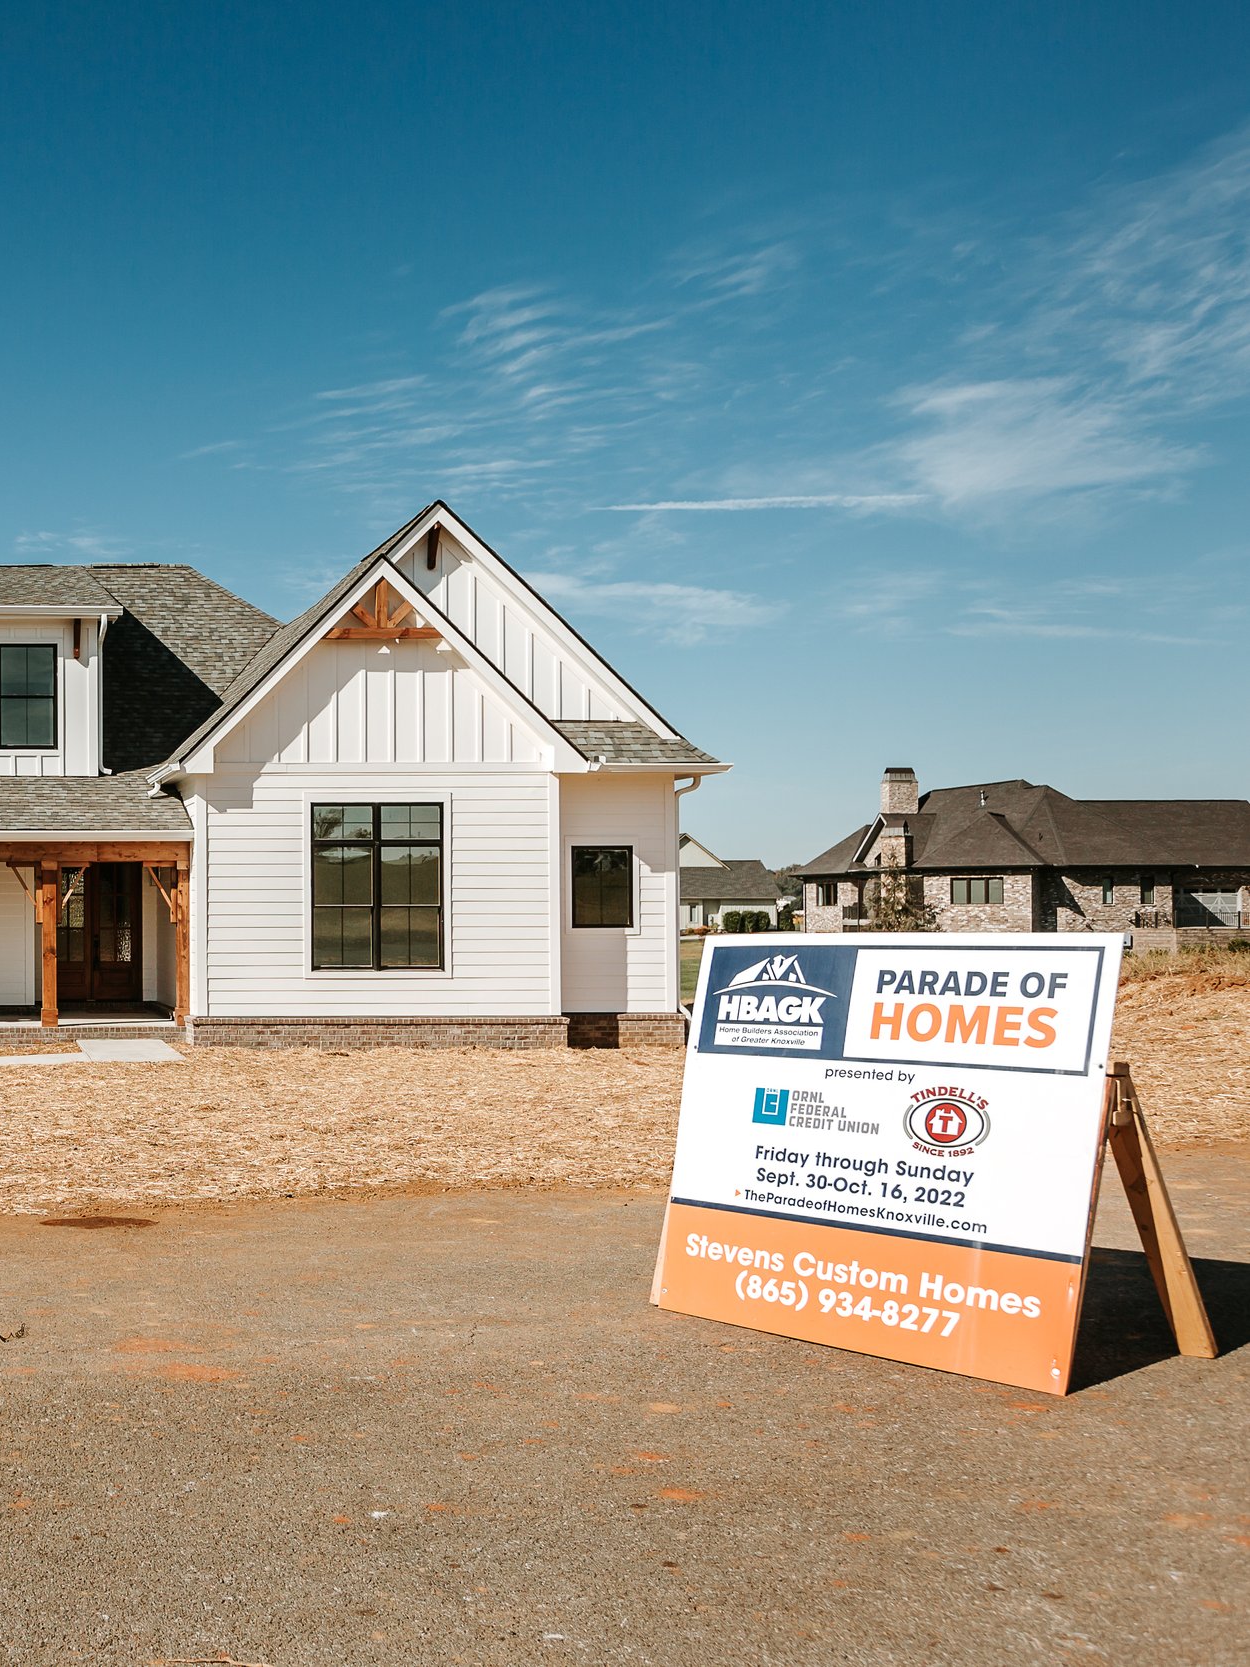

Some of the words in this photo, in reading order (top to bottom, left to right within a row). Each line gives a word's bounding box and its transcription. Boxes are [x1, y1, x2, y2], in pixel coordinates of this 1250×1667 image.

[876, 969, 1010, 997] PARADE
[1019, 971, 1069, 999] OF
[717, 995, 827, 1024] HBAGK
[742, 1027, 772, 1035] Builders
[774, 1029, 819, 1037] Association
[870, 1002, 1058, 1048] HOMES
[770, 1038, 805, 1046] Knoxville
[825, 1068, 894, 1081] presented
[898, 1070, 916, 1085] by
[792, 1090, 824, 1104] ORNL
[910, 1086, 989, 1111] TINDELL'S
[790, 1103, 847, 1119] FEDERAL
[789, 1116, 834, 1131] CREDIT
[837, 1119, 880, 1135] UNION
[912, 1141, 945, 1157] SINCE
[948, 1146, 975, 1158] 1892
[755, 1145, 810, 1168] Friday
[815, 1152, 889, 1177] through
[895, 1160, 975, 1187] Sunday
[756, 1167, 800, 1187] Sept.
[805, 1173, 872, 1196] 30-Oct.
[881, 1182, 908, 1203] 16,
[914, 1186, 966, 1208] 2022
[744, 1189, 988, 1234] TheParadeofHomesKnoxville.com
[686, 1233, 784, 1272] Stevens
[793, 1252, 908, 1295] Custom
[919, 1272, 1041, 1319] Homes
[735, 1270, 809, 1312] (865)
[818, 1288, 960, 1338] 934-8277
